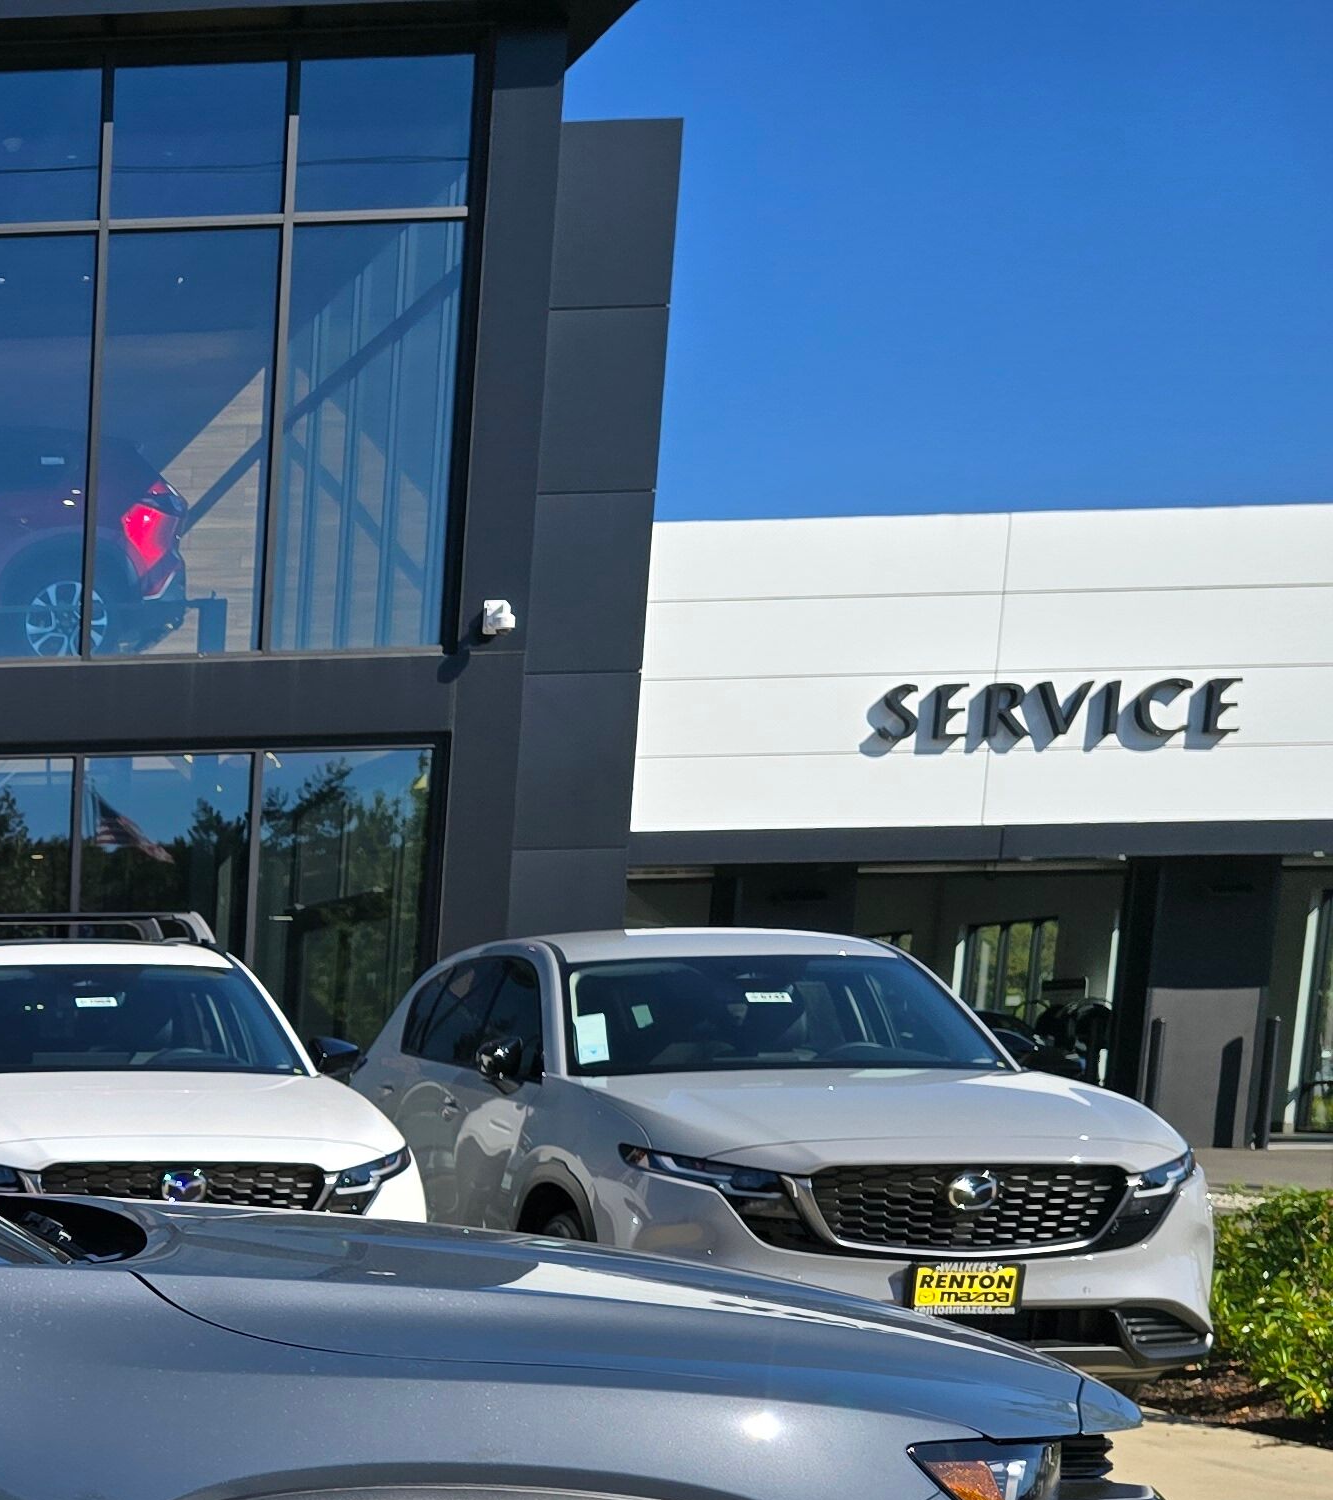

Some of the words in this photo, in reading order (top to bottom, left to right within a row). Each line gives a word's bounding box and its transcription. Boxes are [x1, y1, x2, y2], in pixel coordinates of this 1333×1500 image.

[867, 677, 1244, 744] SERVICE
[939, 1261, 998, 1273] WALKER'S
[919, 1274, 1015, 1289] RENTON
